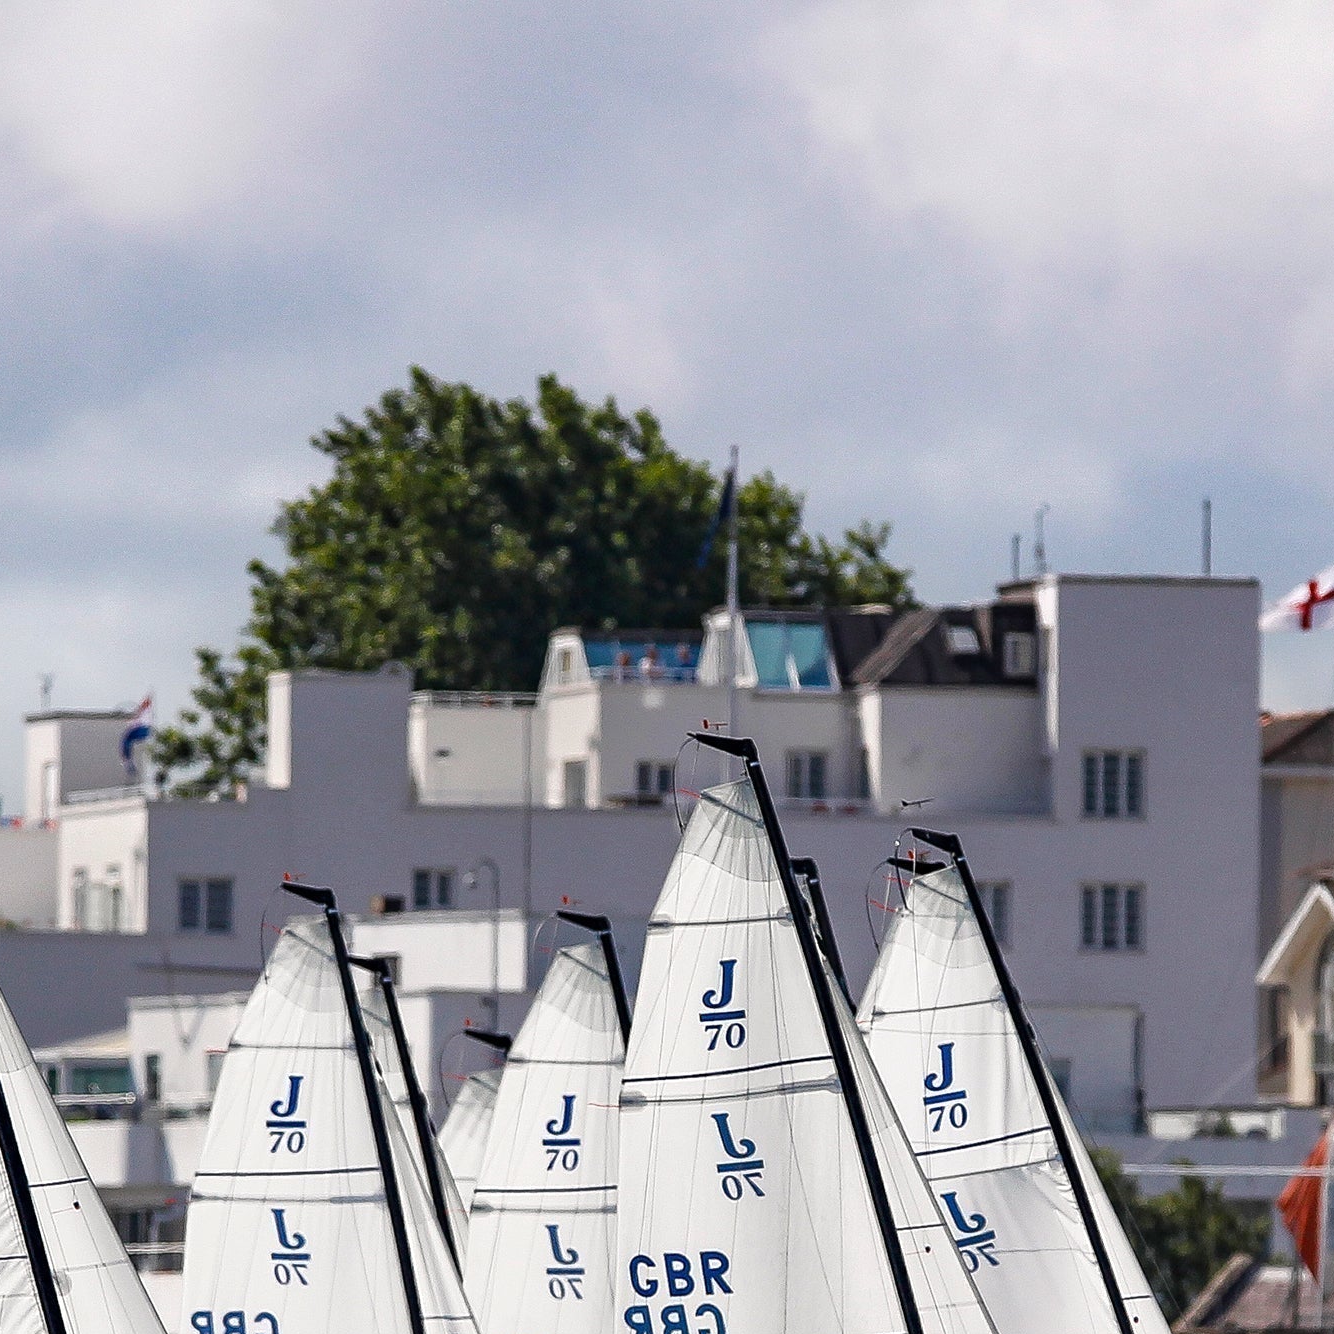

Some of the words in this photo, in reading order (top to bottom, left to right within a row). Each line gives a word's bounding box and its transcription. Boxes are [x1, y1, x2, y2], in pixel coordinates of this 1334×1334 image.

[702, 959, 737, 1009] J
[704, 1023, 746, 1051] 70
[924, 1042, 955, 1092] J
[270, 1076, 304, 1117] J
[546, 1095, 576, 1135] J
[928, 1102, 968, 1132] 70
[269, 1131, 305, 1154] 70
[545, 1149, 579, 1171] 70
[629, 1251, 734, 1298] GBR
